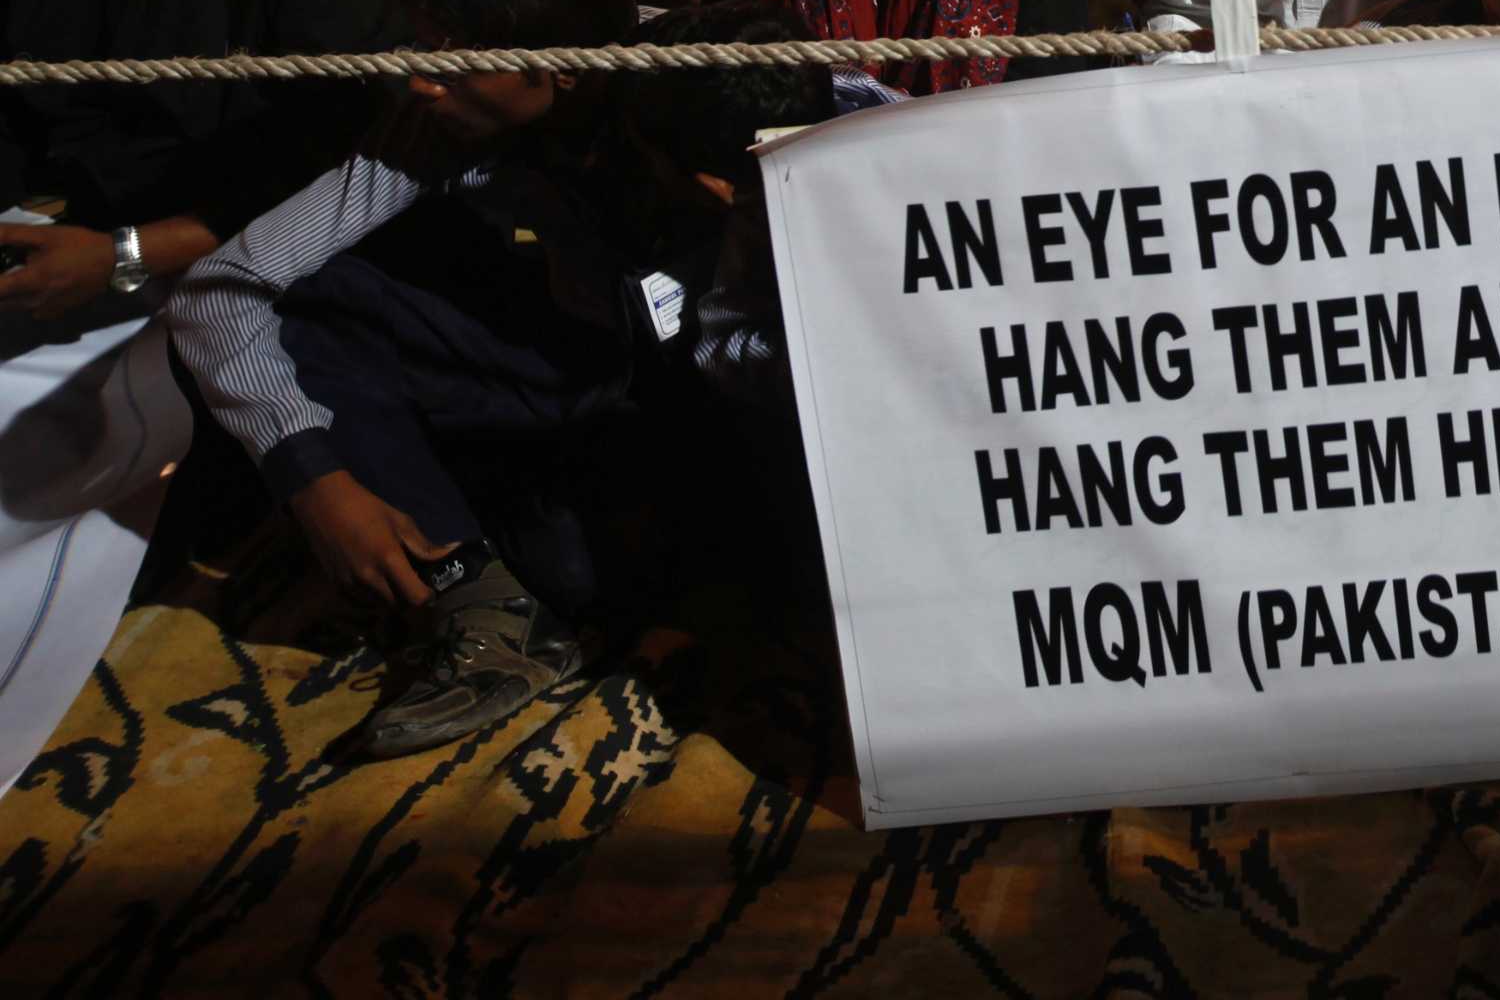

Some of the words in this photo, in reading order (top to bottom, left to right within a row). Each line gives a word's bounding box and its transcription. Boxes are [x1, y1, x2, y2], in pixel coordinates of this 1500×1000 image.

[903, 199, 1005, 294] AN
[1021, 186, 1172, 284] EYE
[1190, 170, 1347, 270] FOR
[1369, 157, 1472, 255] AN
[979, 313, 1195, 414] HANG
[1211, 291, 1428, 394] THEM
[974, 436, 1187, 535] HANG
[1202, 417, 1416, 517] THEM
[1012, 580, 1212, 689] MQM
